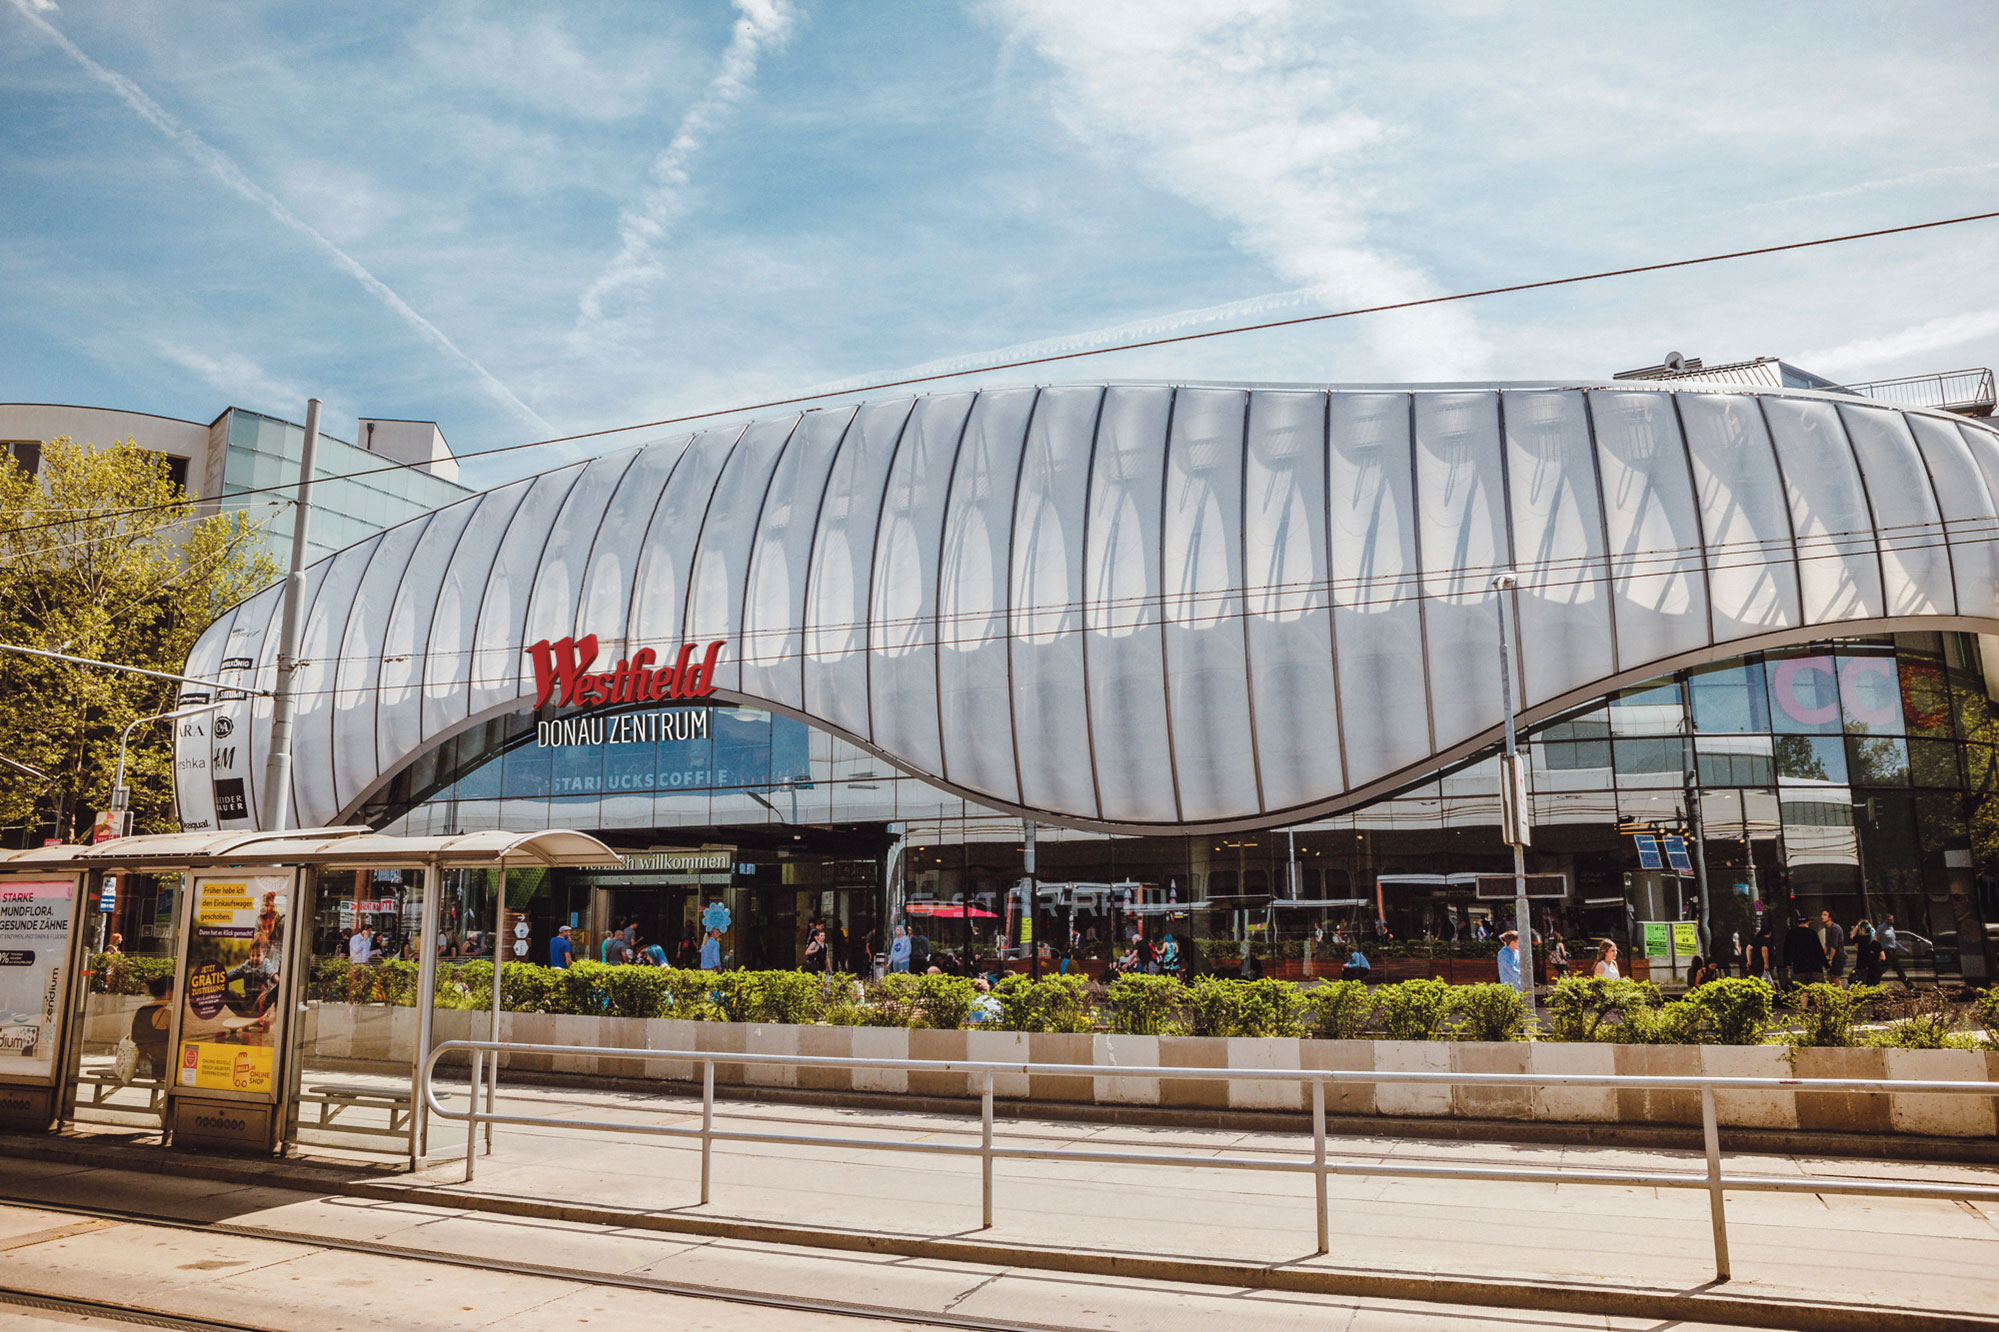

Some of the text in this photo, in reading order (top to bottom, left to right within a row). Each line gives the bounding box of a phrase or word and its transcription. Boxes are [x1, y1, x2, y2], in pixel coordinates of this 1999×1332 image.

[524, 634, 727, 710] Westfield
[1774, 654, 1946, 729] CCC
[178, 724, 205, 738] ARA
[538, 709, 709, 748] DONAU ZENTRUM
[554, 769, 728, 792] STARUCKS COFFE
[639, 853, 727, 870] willkommen
[203, 886, 222, 894] Früher
[2, 892, 34, 903] STARKE
[213, 899, 253, 909] Einkaufswagen
[0, 905, 54, 917] MUNDFLORA.
[200, 913, 232, 922] geschoben.
[0, 917, 68, 931] GESUNDE ZÄHNE
[201, 964, 216, 974] JETZT
[191, 971, 226, 988] GRATIS
[46, 967, 60, 1024] zendium
[191, 983, 226, 996] ZUSTELLUNG
[0, 1033, 23, 1048] dium
[249, 1070, 270, 1079] ONLINE
